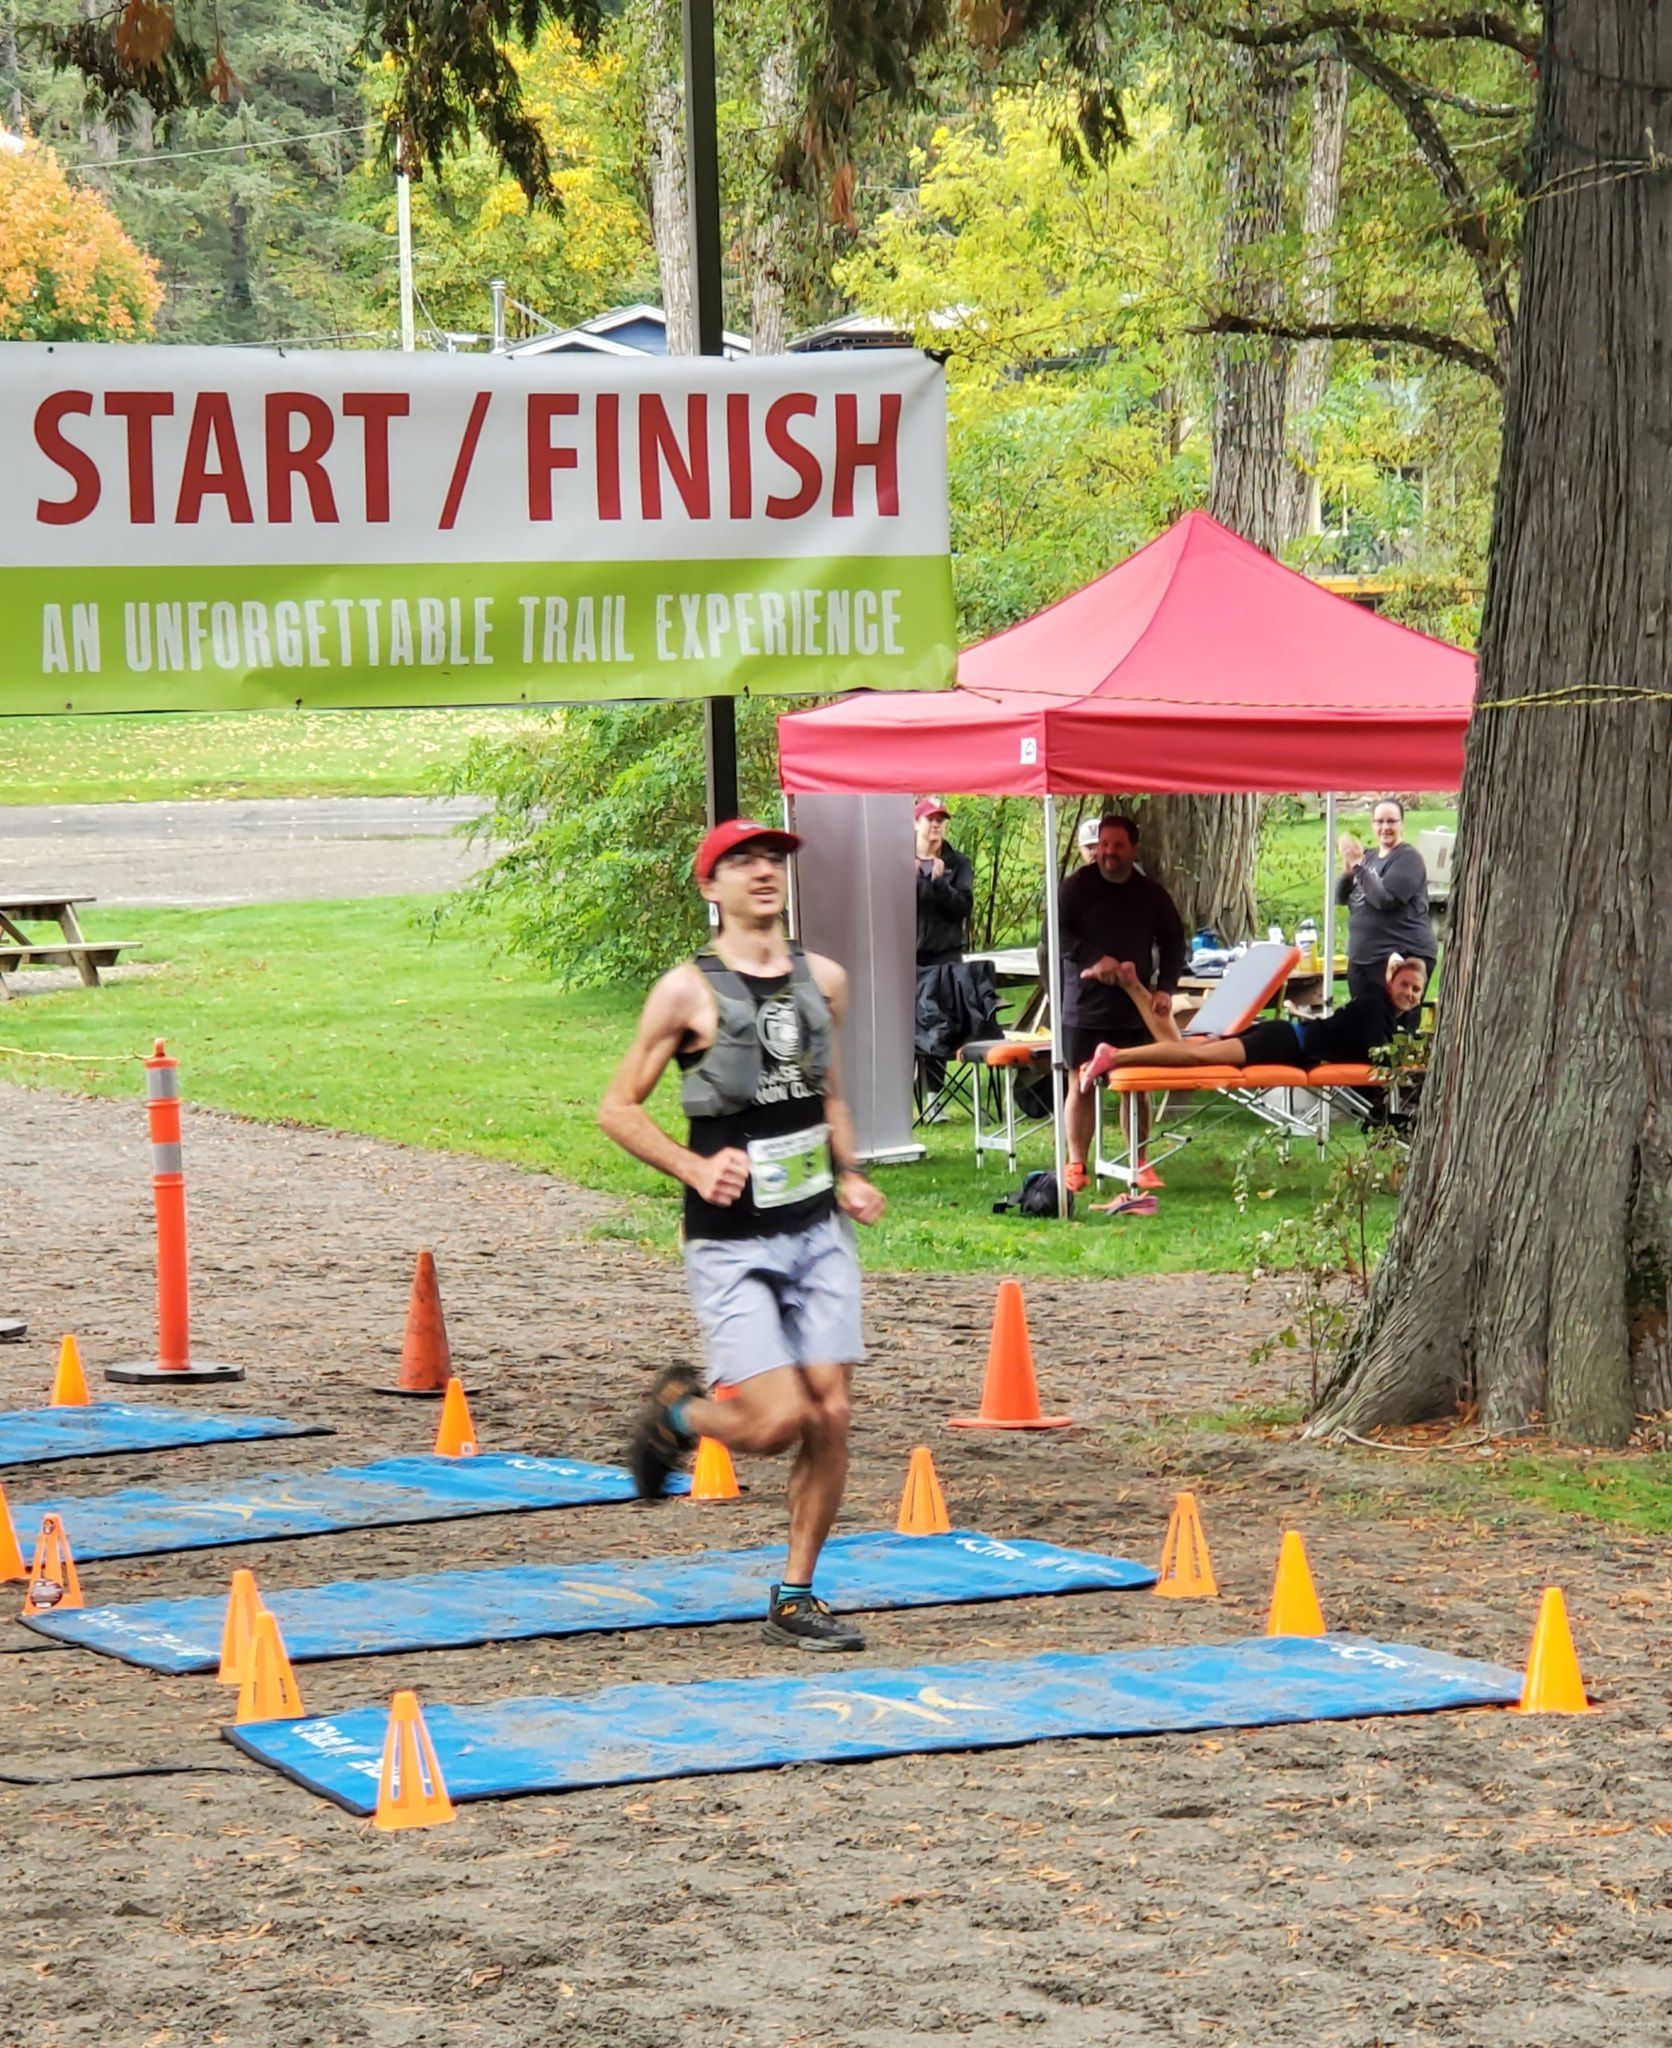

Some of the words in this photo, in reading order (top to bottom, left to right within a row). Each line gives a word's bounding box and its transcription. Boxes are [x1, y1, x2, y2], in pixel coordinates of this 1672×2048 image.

[34, 389, 410, 525] START
[438, 391, 492, 530] /
[527, 392, 903, 521] FINISH
[42, 603, 100, 673] AN
[124, 597, 495, 672] UNFORGETTABLE
[519, 594, 634, 664] TRAIL
[656, 588, 905, 660] EXPERIENCE
